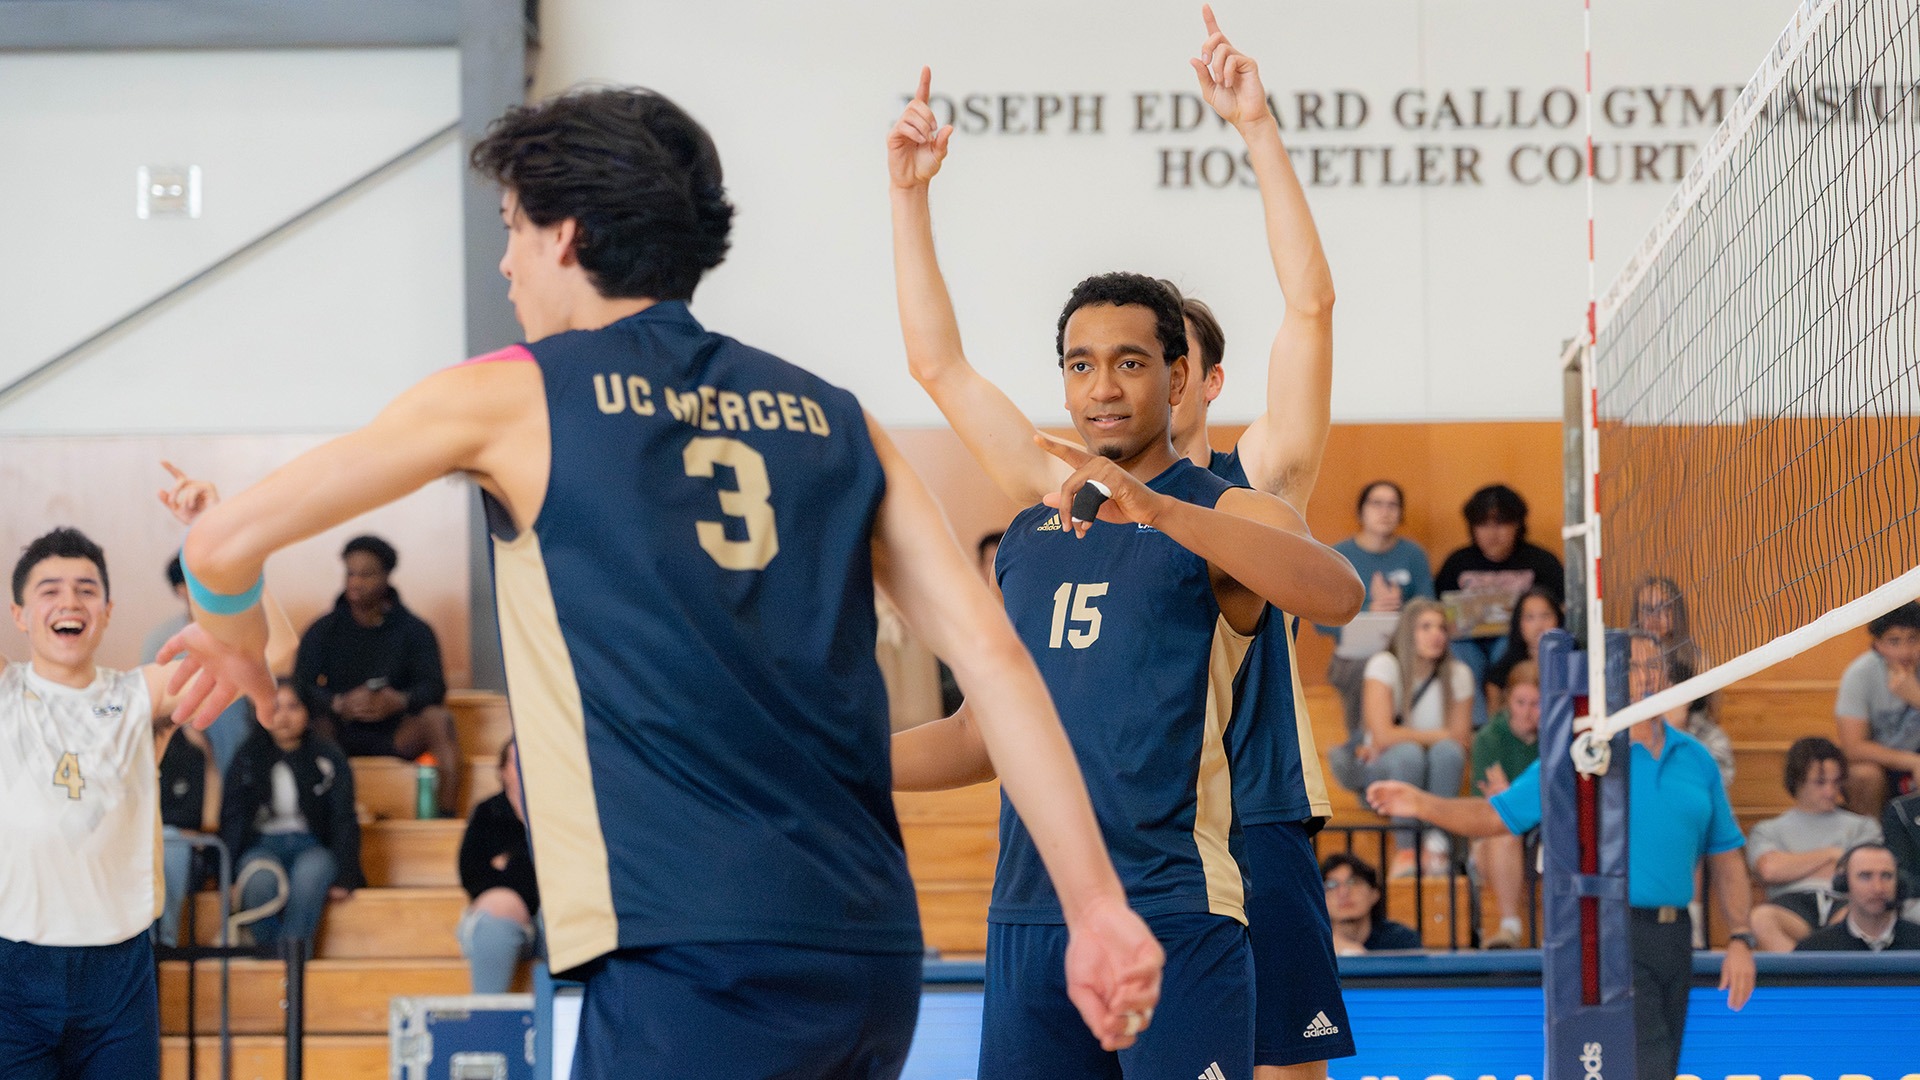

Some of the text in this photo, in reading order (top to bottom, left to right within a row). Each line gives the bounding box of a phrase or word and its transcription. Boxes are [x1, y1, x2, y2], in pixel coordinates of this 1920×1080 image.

[893, 85, 1920, 135] OSEPH EDRD GALLO GYMASIU
[1159, 142, 1698, 188] HOSETLER COURT
[593, 373, 831, 437] UC MERCED
[682, 436, 779, 571] 3
[1049, 582, 1109, 649] 15
[53, 751, 85, 800] 4
[1303, 1025, 1339, 1038] adidas
